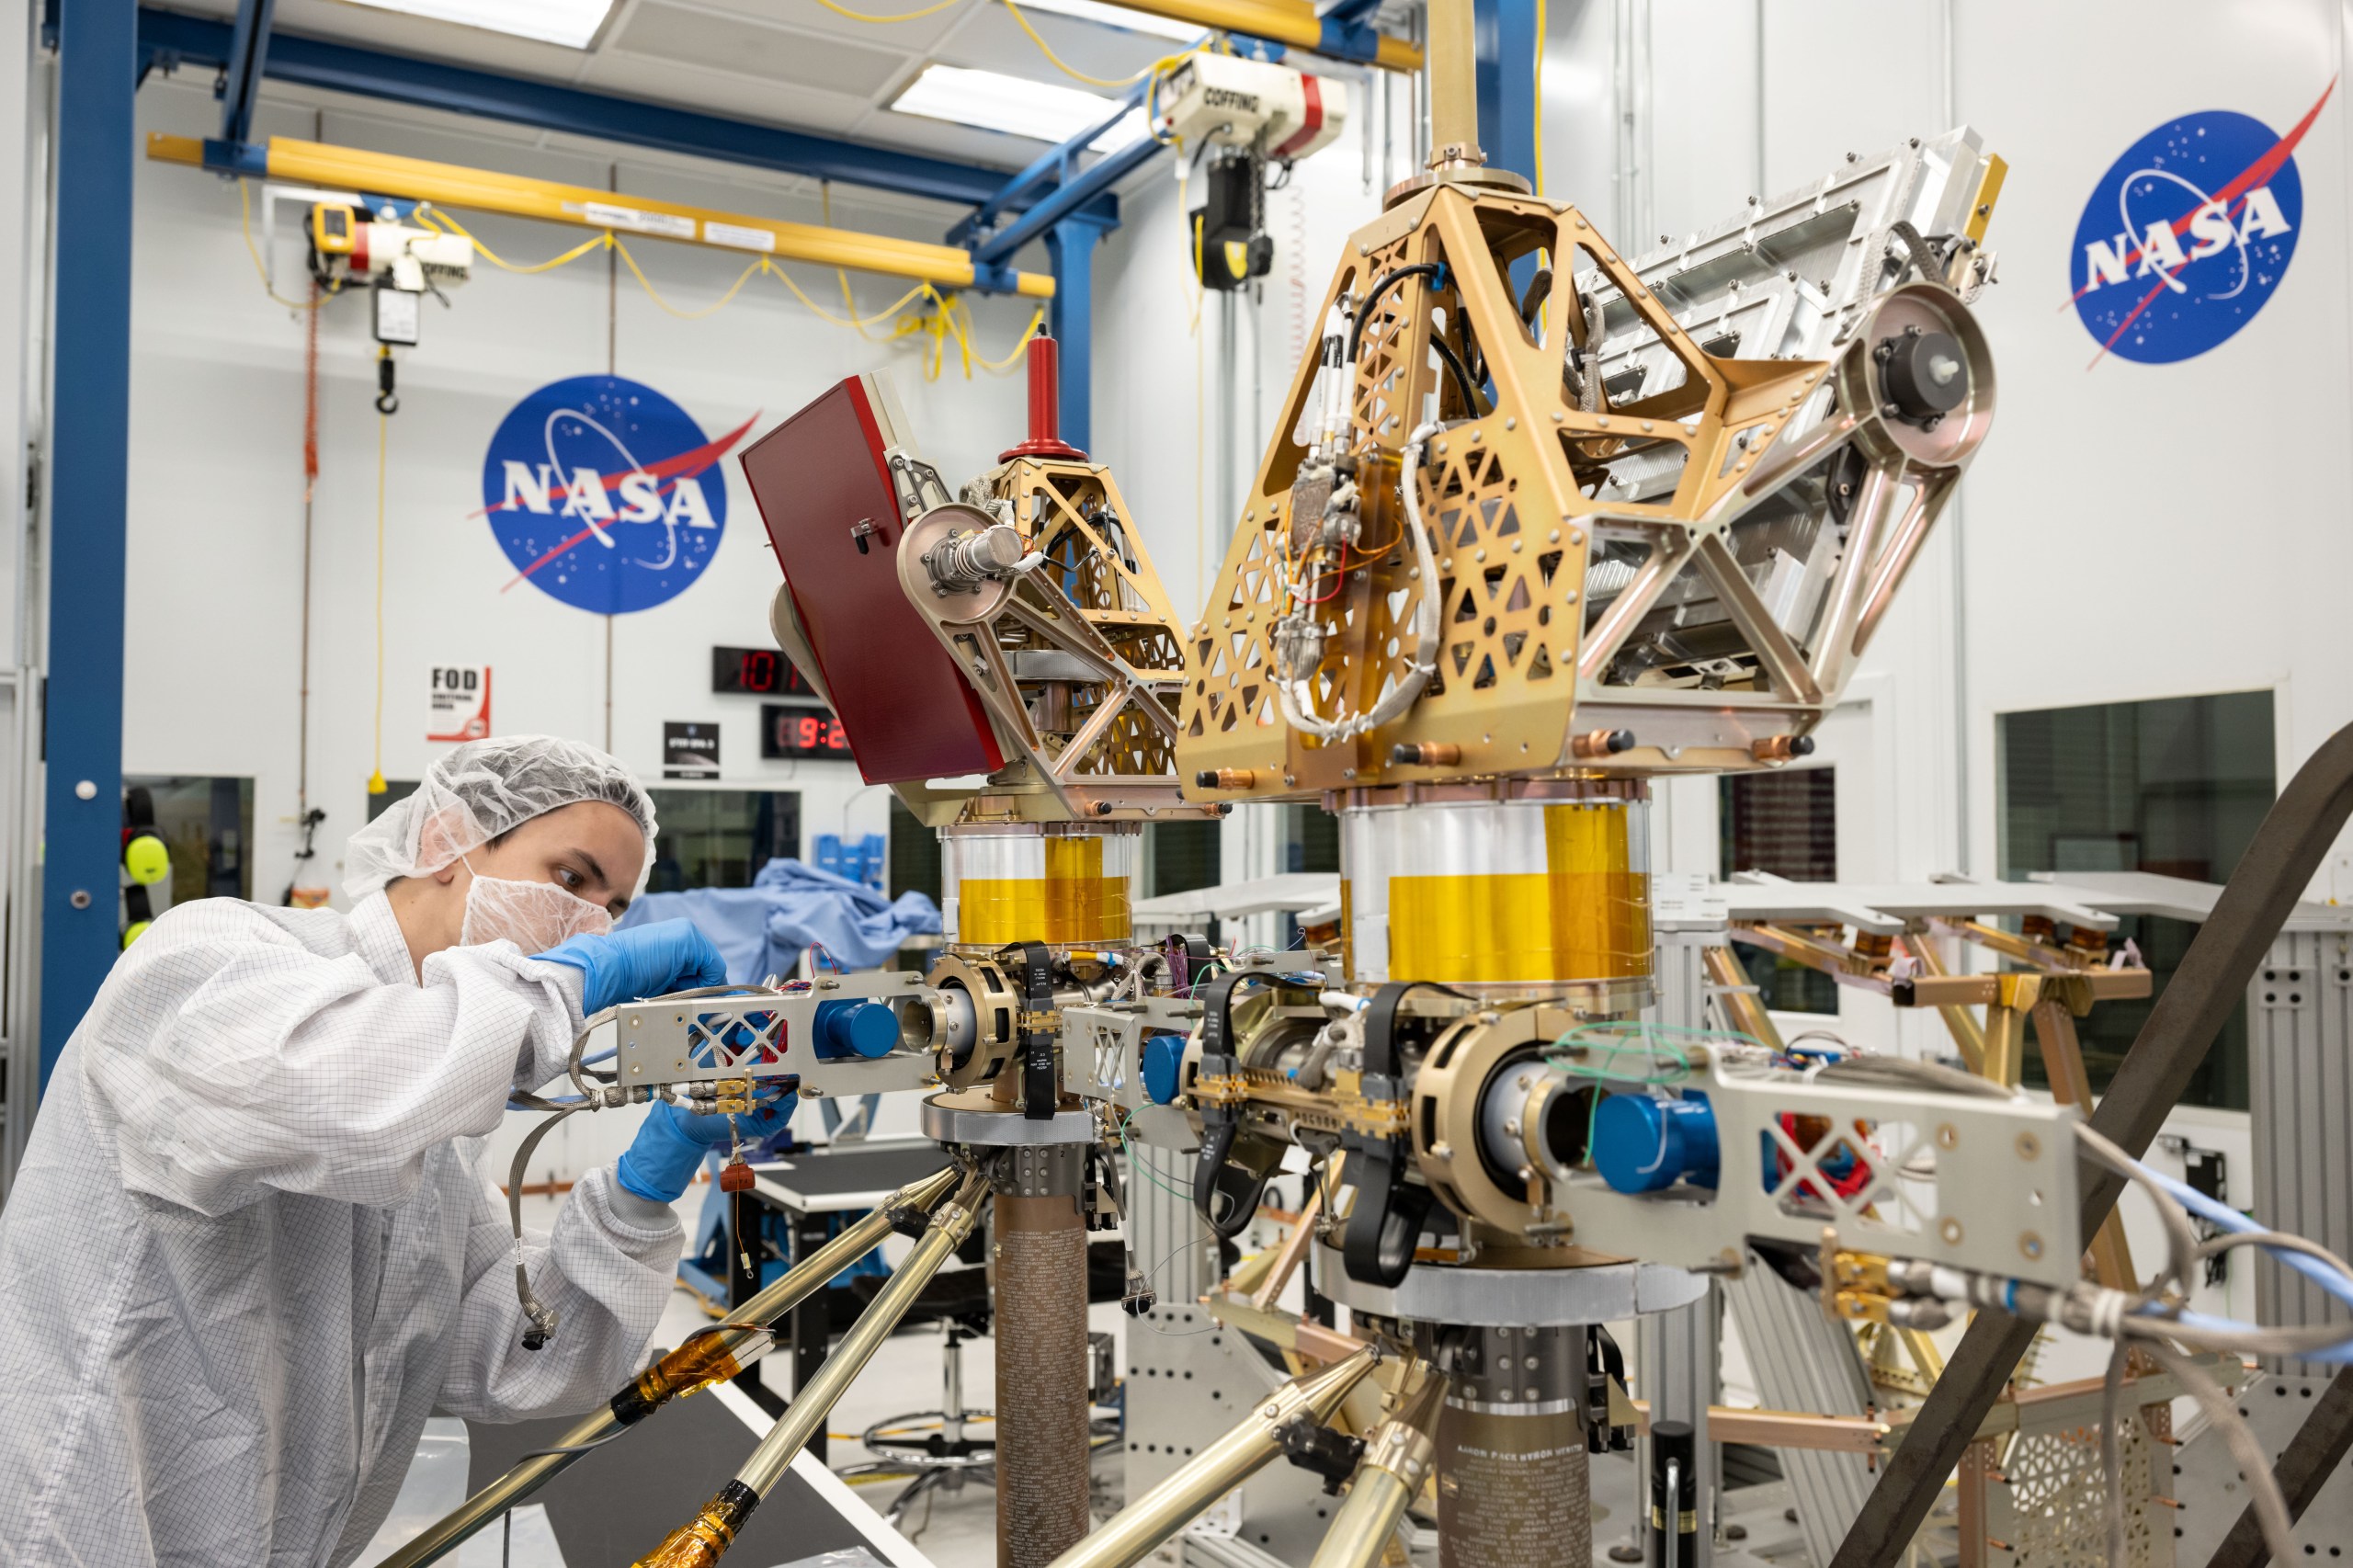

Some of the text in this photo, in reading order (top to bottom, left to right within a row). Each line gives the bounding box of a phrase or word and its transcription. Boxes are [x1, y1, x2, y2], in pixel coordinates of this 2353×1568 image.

[1204, 87, 1259, 113] COFFING
[2083, 185, 2292, 292] NASA
[501, 460, 718, 529] NASA
[433, 668, 477, 690] FOD
[799, 717, 847, 749] 9:2
